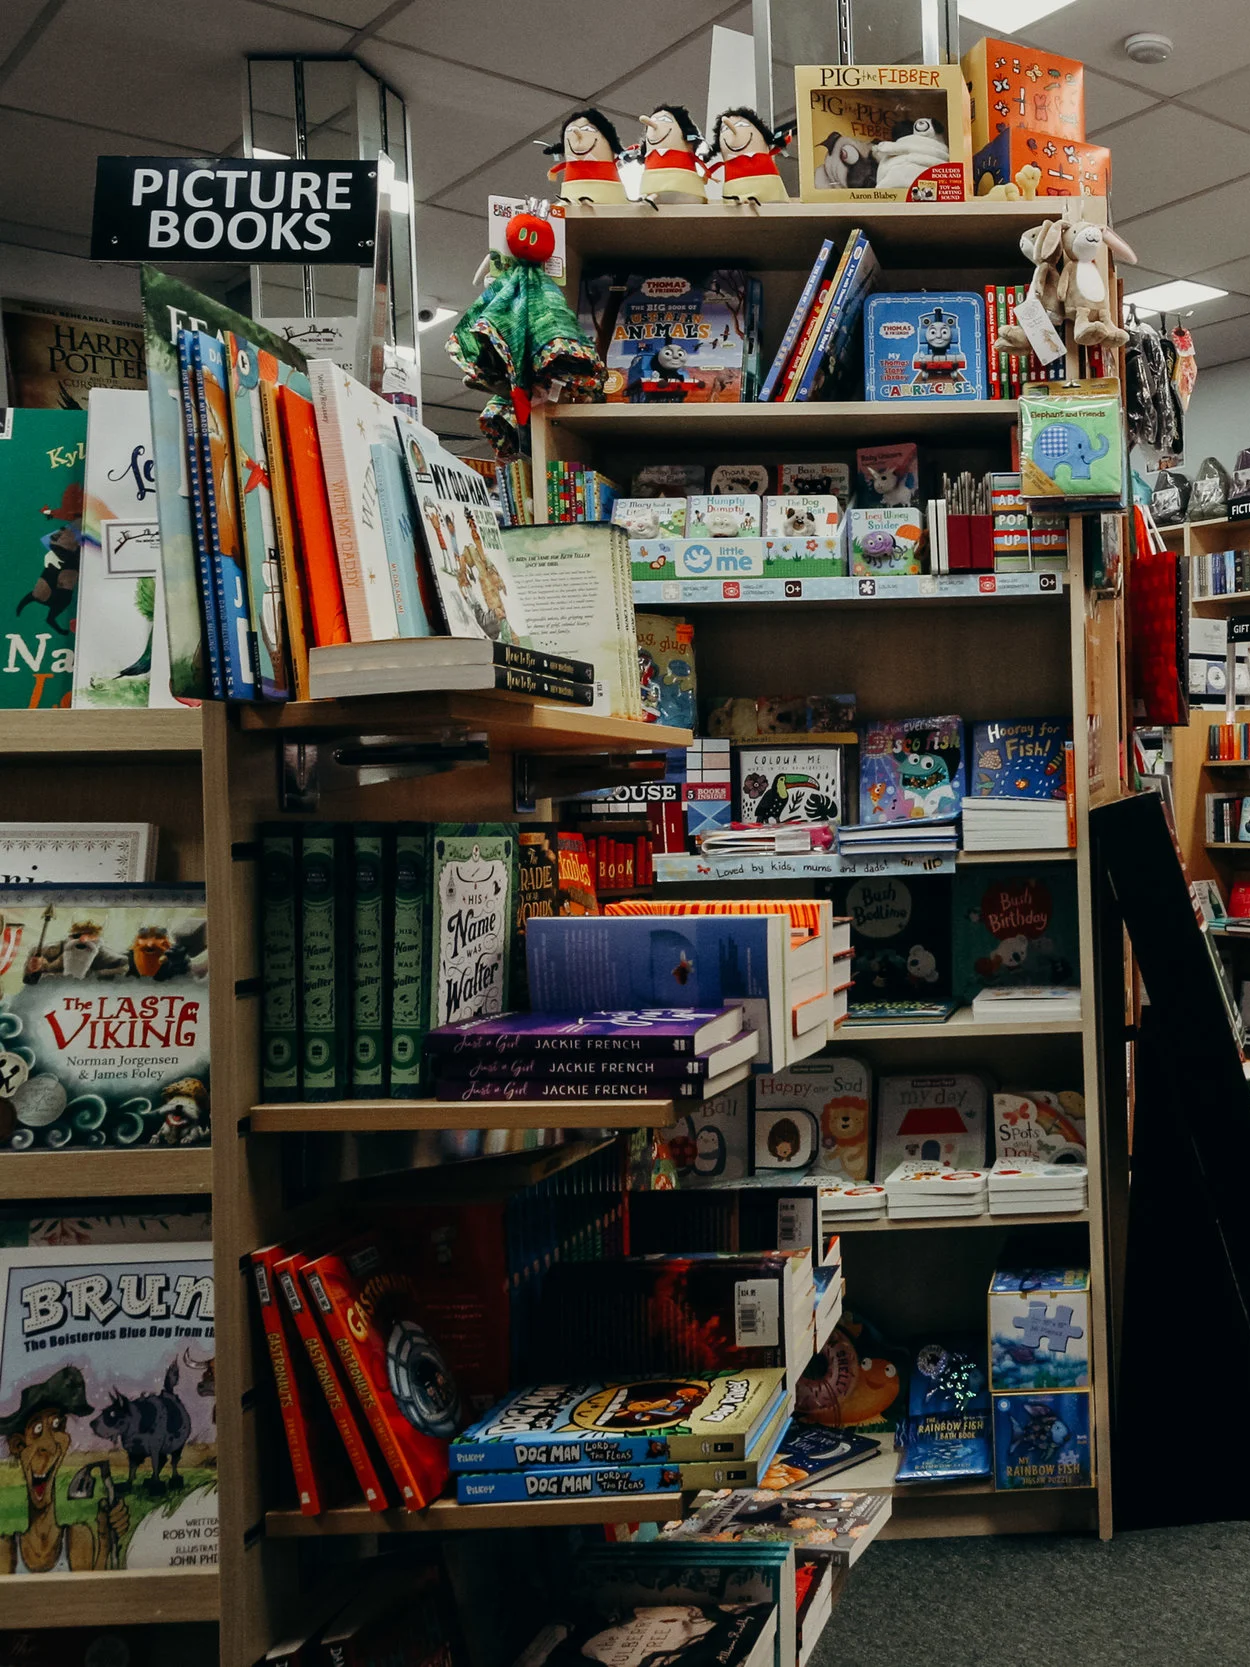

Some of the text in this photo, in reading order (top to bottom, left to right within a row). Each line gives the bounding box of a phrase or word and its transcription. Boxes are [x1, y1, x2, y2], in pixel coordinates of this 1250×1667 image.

[820, 68, 940, 87] PIG the FIBBER
[132, 168, 353, 210] PICTURE
[850, 191, 898, 201] Aaron Blabey
[148, 210, 331, 251] BOOKS
[646, 281, 687, 290] THOMAS
[647, 303, 666, 311] BIG
[614, 323, 712, 340] ANIMALS
[53, 323, 146, 358] HARRY
[1030, 411, 1064, 419] Elephant
[430, 463, 490, 507] MY OLD MAN
[999, 495, 1024, 506] ABC
[998, 515, 1024, 525] POP
[1004, 535, 1021, 546] UP
[1042, 535, 1058, 545] UP
[719, 547, 744, 555] little
[716, 556, 752, 571] me
[1233, 623, 1249, 633] GIFT
[660, 639, 687, 654] glug
[988, 724, 1059, 743] Hooray for
[1005, 739, 1050, 760] Fish!
[755, 755, 821, 765] COLOUR ME
[687, 790, 695, 799] 5
[717, 860, 889, 879] Loved by kids, mums and dads!
[468, 895, 483, 905] HIS
[1001, 892, 1032, 910] Bush
[988, 912, 1048, 933] Birthday
[448, 910, 496, 958] Name
[466, 943, 482, 958] WAS
[447, 953, 498, 1012] Walter
[63, 995, 185, 1020] The LAST
[45, 1001, 200, 1050] VIKING
[535, 1038, 640, 1049] JACKIE FRENCH
[66, 1054, 179, 1067] Norman Jorgensen
[549, 1061, 654, 1073] JACKIE FRENCH
[78, 1068, 164, 1081] & James Foley
[462, 1078, 647, 1099] Just Girl JACKIE FRENCH
[759, 1078, 811, 1099] Happy
[833, 1076, 863, 1093] Sad
[1000, 1123, 1040, 1142] Spots
[24, 1339, 46, 1352] The
[120, 1326, 147, 1339] Blue
[150, 1325, 172, 1339] Dog
[174, 1325, 202, 1338] from
[267, 1332, 294, 1409] GASTRONAUTS
[305, 1337, 343, 1410] GASTRONAUTS
[336, 1338, 376, 1409] GASTRONAUTS
[918, 1420, 984, 1433] RAINBOW FISH
[516, 1446, 548, 1464] DOG
[550, 1444, 580, 1463] MAN
[585, 1441, 608, 1452] LORD
[597, 1471, 620, 1483] LORD
[1006, 1463, 1080, 1476] RAINBOW FISH
[526, 1476, 558, 1494] DOG
[562, 1474, 592, 1492] MAN
[163, 1529, 200, 1540] ROBYN
[169, 1556, 195, 1566] JOHN
